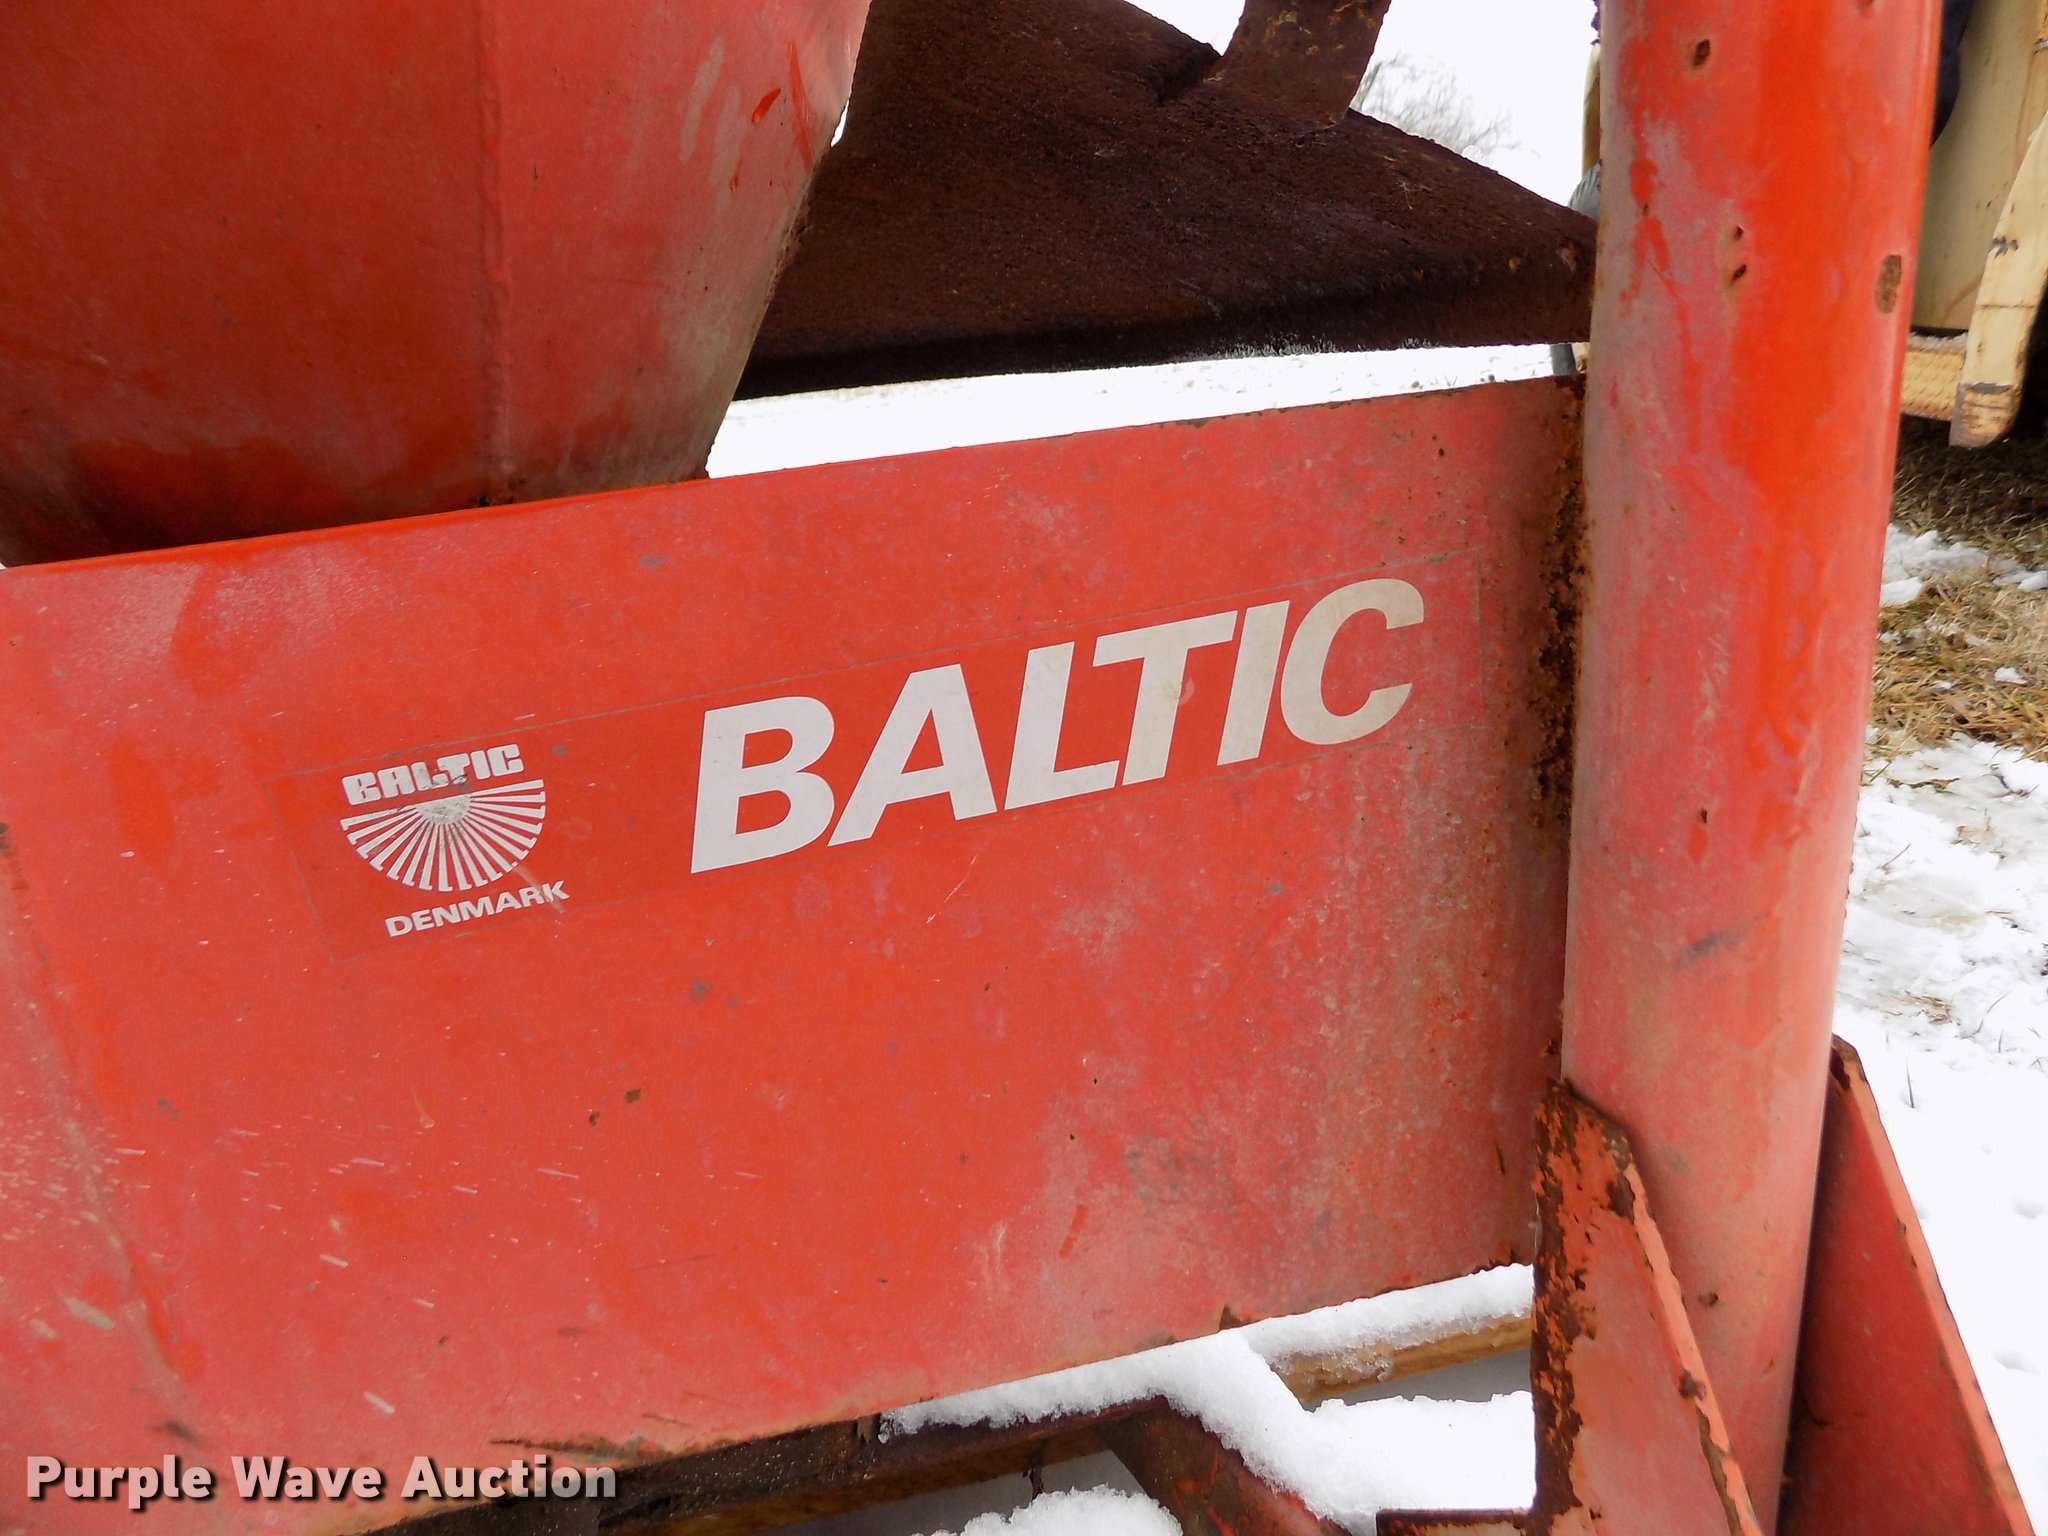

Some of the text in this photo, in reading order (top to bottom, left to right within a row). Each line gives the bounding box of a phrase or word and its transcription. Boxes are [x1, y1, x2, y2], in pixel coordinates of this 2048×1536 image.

[690, 578, 1425, 874] BALTIC
[341, 743, 524, 805] BALTIC
[385, 880, 570, 937] DENMARK
